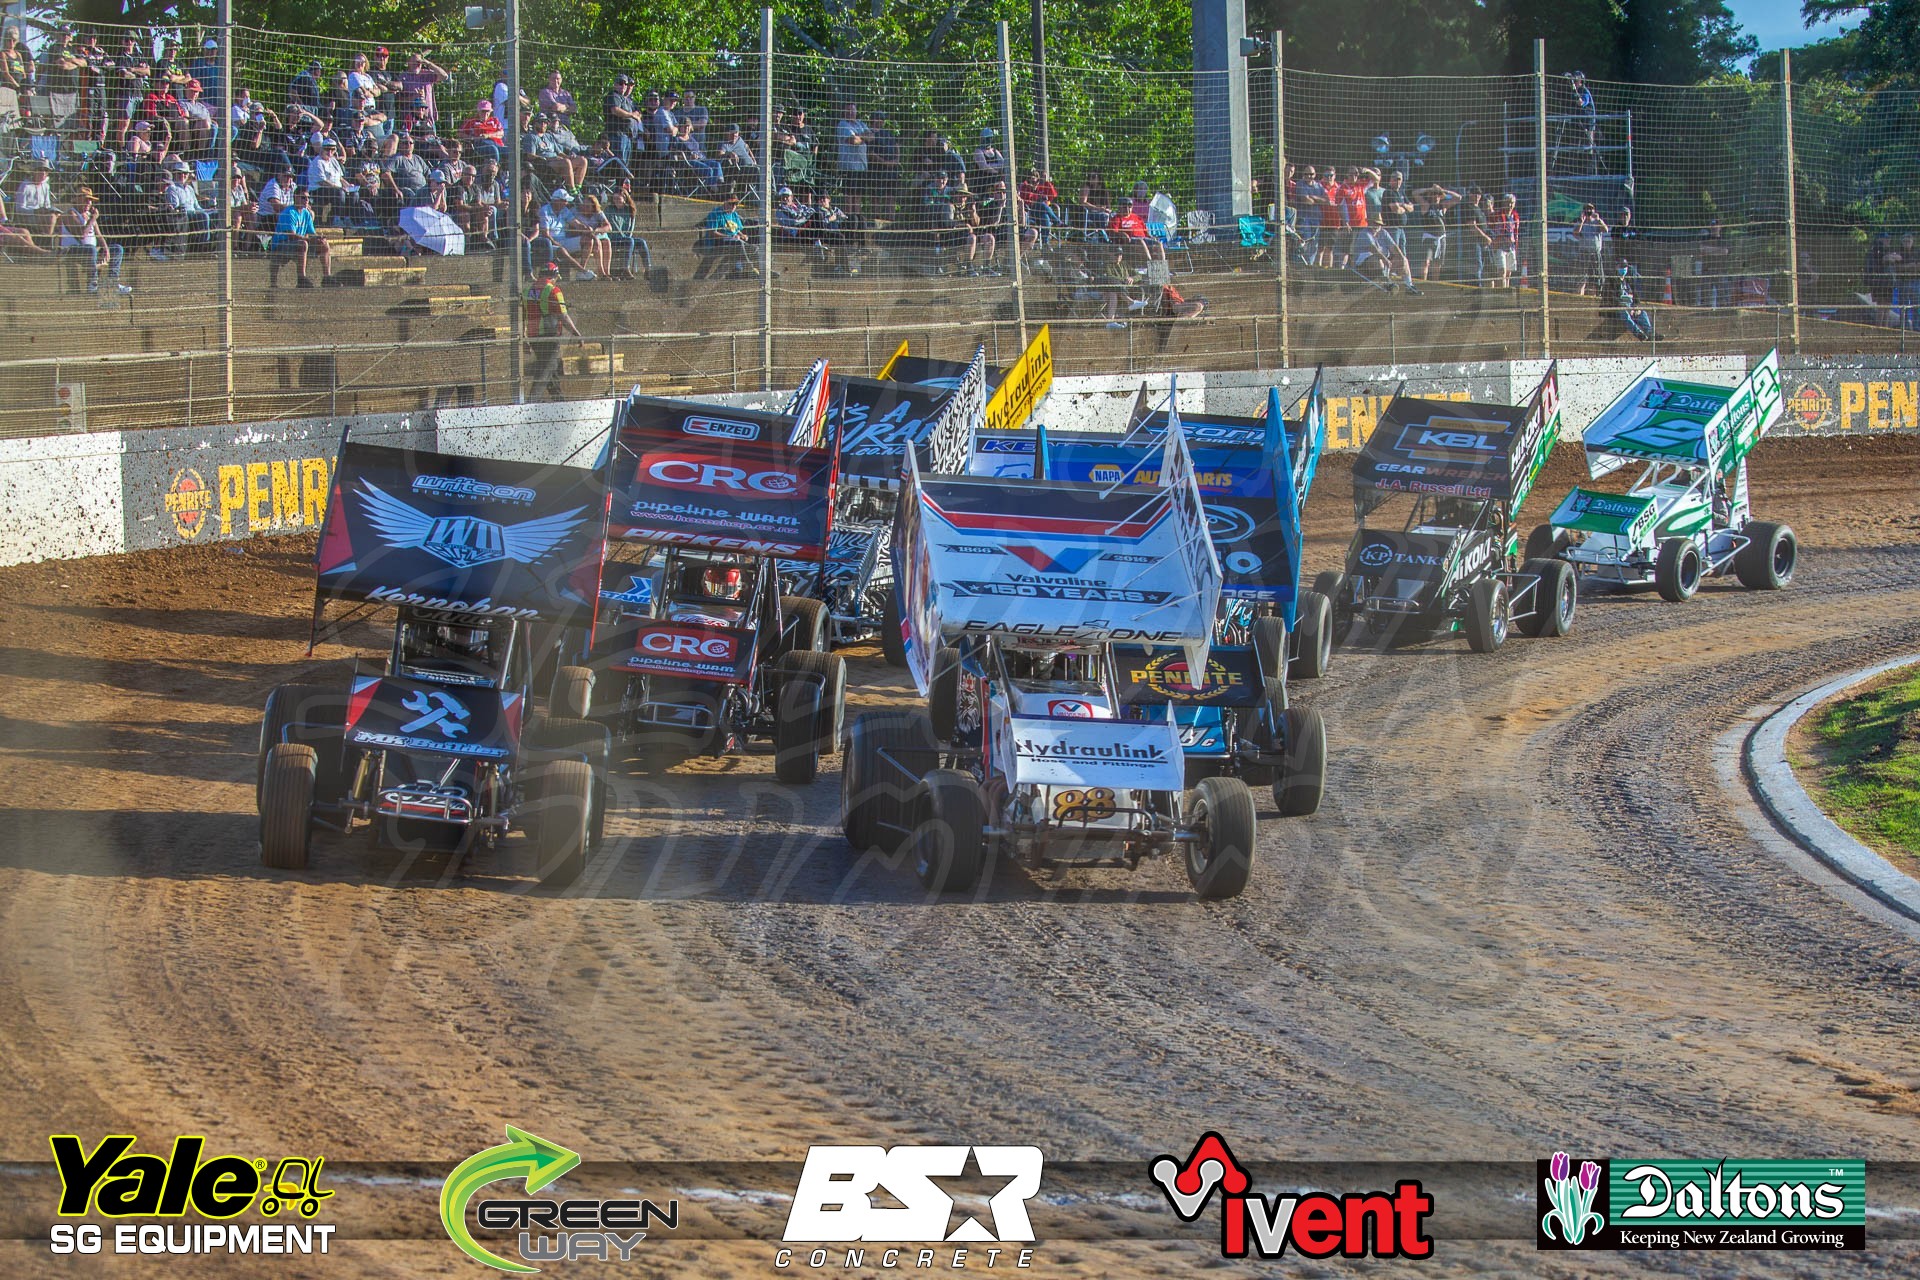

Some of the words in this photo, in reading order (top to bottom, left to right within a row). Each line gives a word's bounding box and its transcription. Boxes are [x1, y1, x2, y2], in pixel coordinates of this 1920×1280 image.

[1753, 366, 1780, 414] 2
[709, 422, 751, 436] ENZED
[1418, 430, 1497, 451] KBL
[649, 459, 797, 494] CRC
[1094, 470, 1121, 482] NAPA
[219, 456, 338, 534] PENR
[1409, 480, 1464, 496] Russell
[1465, 484, 1491, 499] Ltd
[622, 528, 803, 556] PICKENS
[957, 546, 992, 554] 1866
[1113, 554, 1148, 563] 2016
[1365, 550, 1389, 561] KP
[1005, 573, 1107, 587] Valvoline
[983, 583, 1037, 597] 150
[1043, 586, 1145, 603] YEARS
[962, 620, 1080, 637] EAGLE
[1107, 628, 1183, 643] ONE
[641, 632, 730, 658] CRC
[1053, 787, 1117, 823] 88
